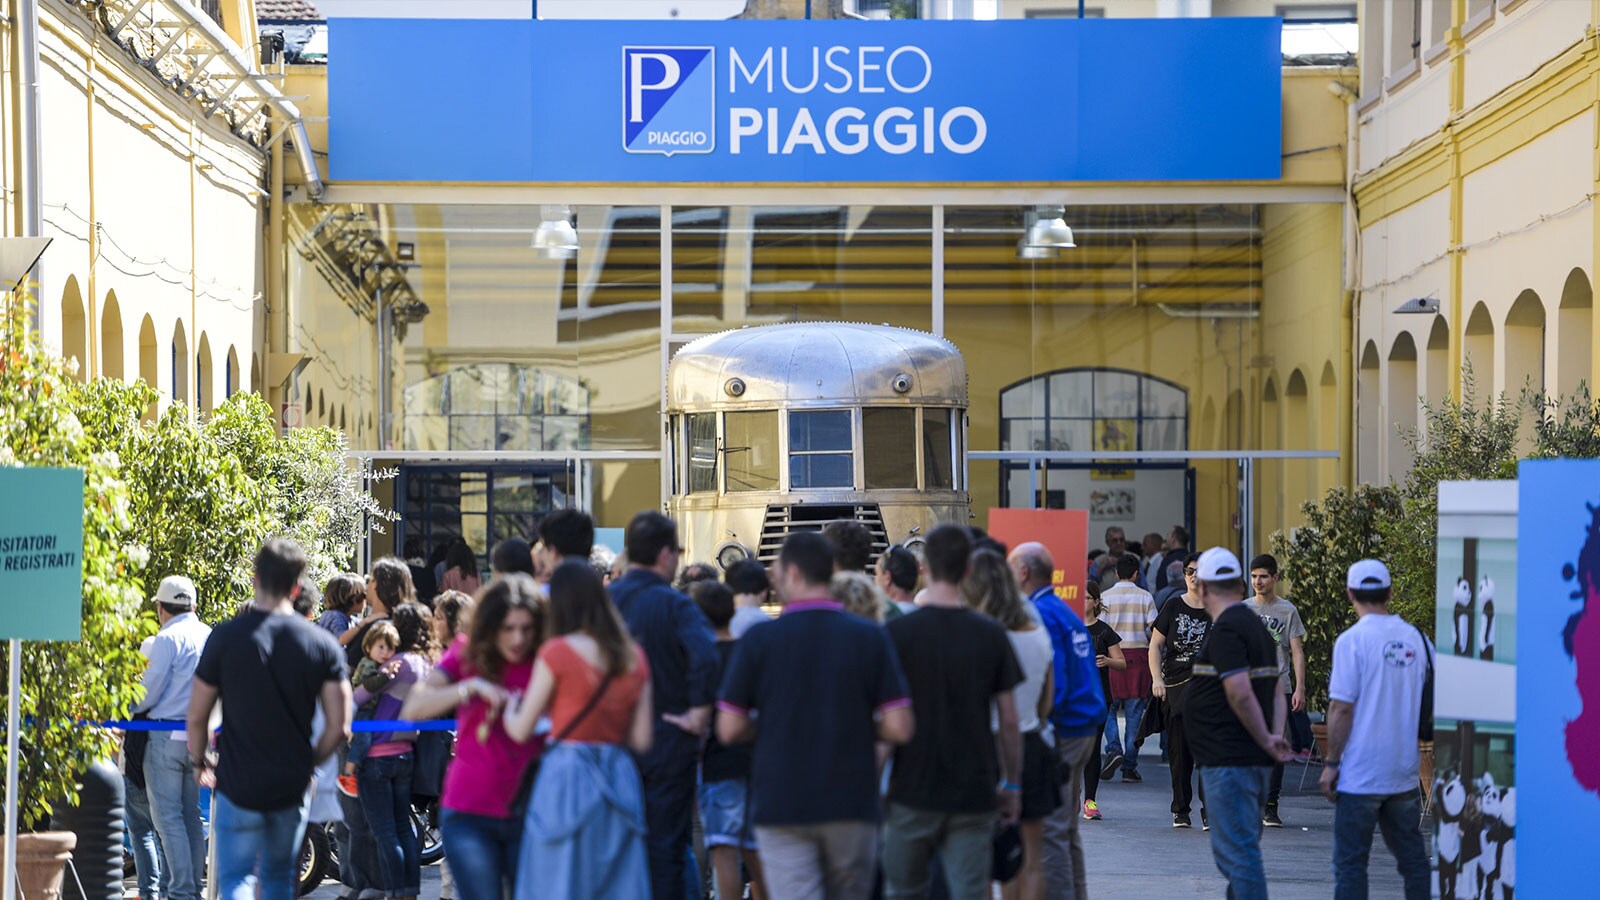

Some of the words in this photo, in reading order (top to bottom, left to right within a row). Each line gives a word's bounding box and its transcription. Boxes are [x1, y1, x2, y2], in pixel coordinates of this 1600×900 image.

[629, 53, 681, 122] P
[729, 46, 932, 93] MUSEO
[648, 131, 707, 145] PIAGGIO
[729, 106, 987, 154] PIAGGIO
[5, 553, 75, 571] REGISTRATI
